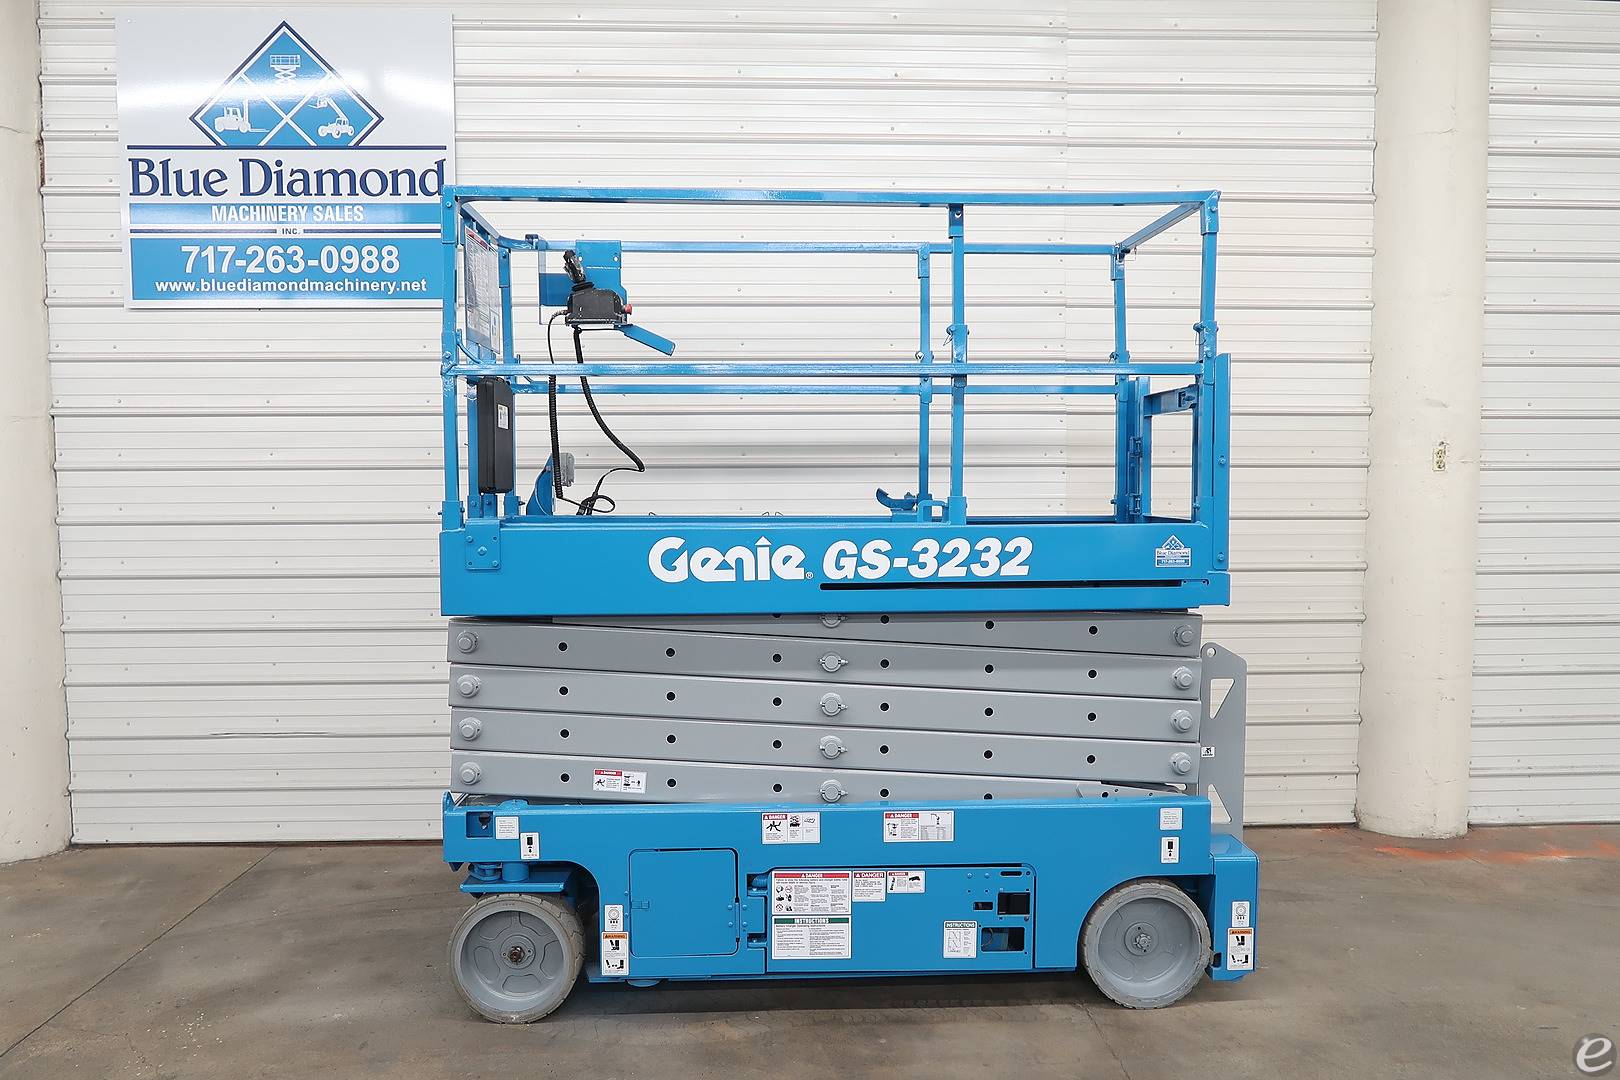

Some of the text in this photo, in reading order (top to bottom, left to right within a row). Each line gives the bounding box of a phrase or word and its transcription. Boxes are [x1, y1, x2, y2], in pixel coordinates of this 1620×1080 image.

[128, 158, 446, 197] Blue Diamond
[211, 205, 364, 222] MACHINERY SALES
[281, 227, 300, 236] INC.
[180, 244, 400, 274] 717-263-0988
[155, 278, 427, 295] www.bluediamondmachinery.net
[822, 536, 1034, 580] GS-3232
